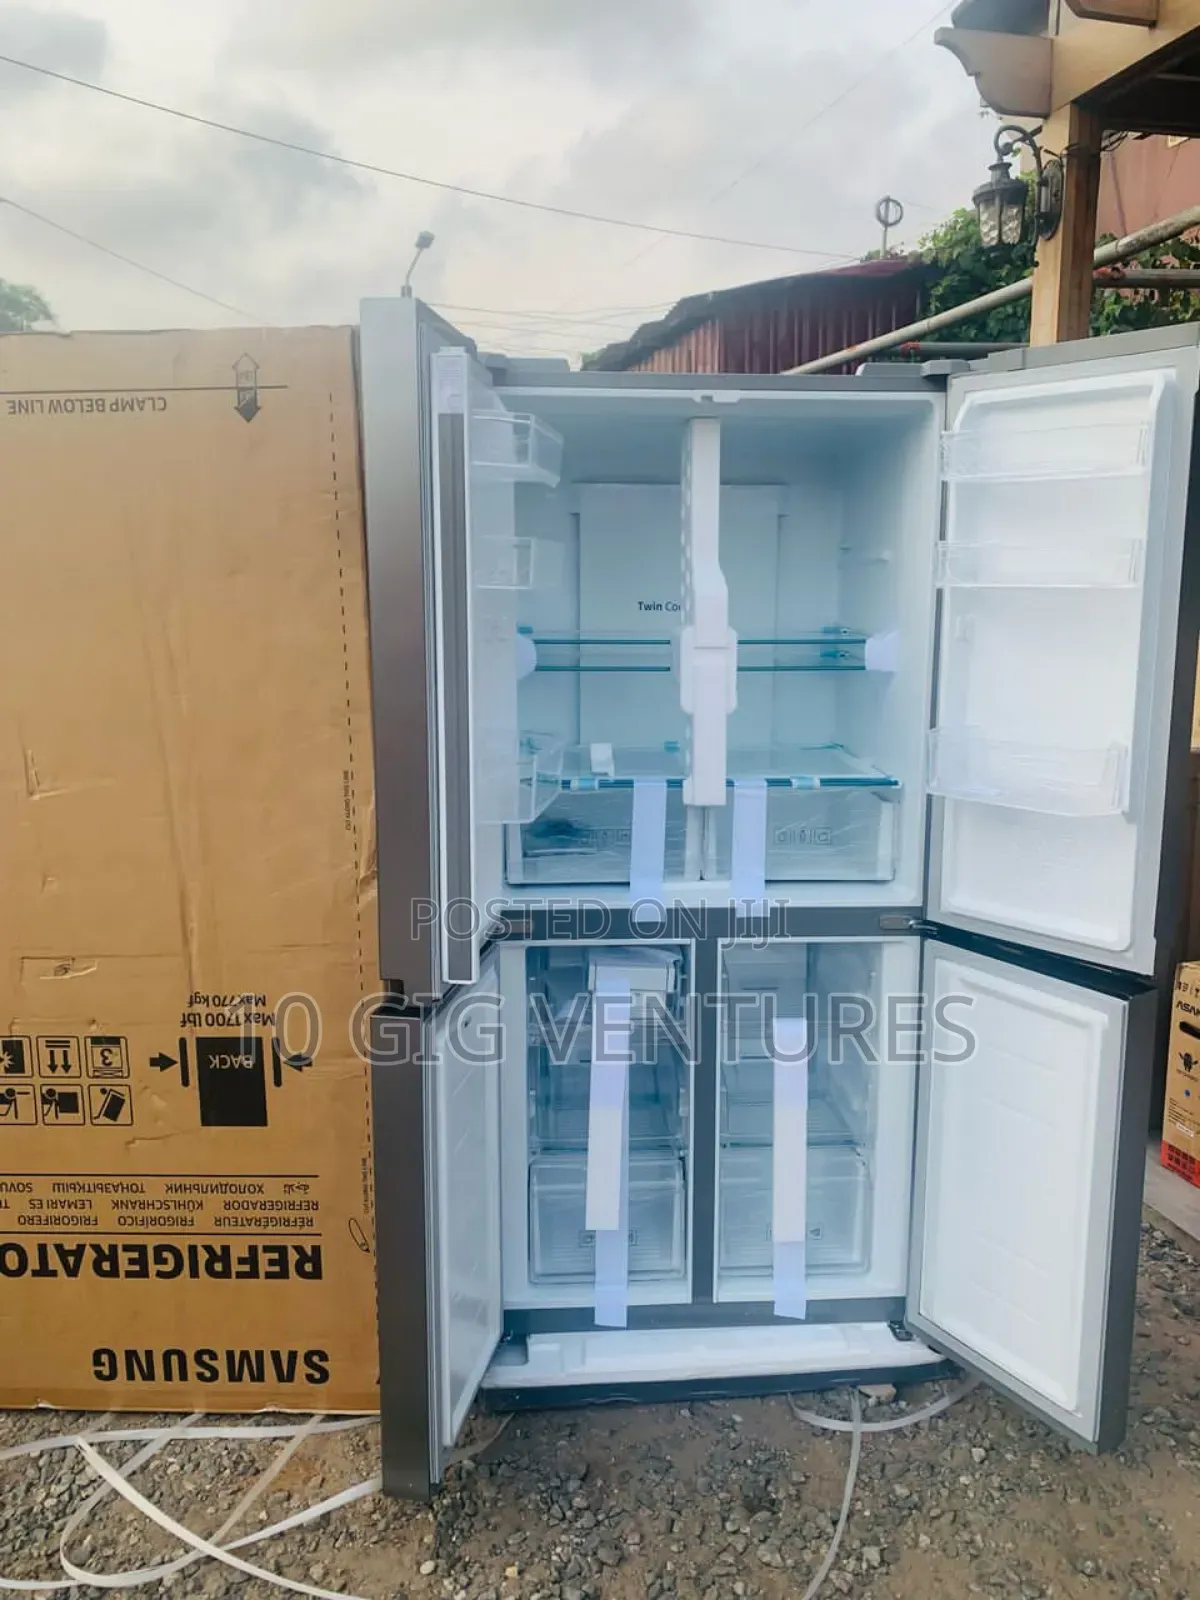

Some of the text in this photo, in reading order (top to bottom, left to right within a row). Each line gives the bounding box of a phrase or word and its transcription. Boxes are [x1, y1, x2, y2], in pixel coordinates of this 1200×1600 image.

[7, 396, 167, 415] CLAMP BELOW LINE
[637, 600, 662, 611] Twin
[188, 991, 210, 1008] kgf
[180, 1012, 275, 1028] Max 1700 lbf
[100, 1048, 113, 1066] 3
[208, 1054, 254, 1069] BACK
[165, 1182, 264, 1195] ХОЛОДИЛЬНИК
[29, 1198, 92, 1210] LEMARI ES
[111, 1199, 204, 1213] KÜHLSCHRANK
[223, 1199, 319, 1211] REFRIGERADOR
[17, 1214, 99, 1226] FRIGORIFERO
[117, 1215, 195, 1229] FRIGORÍFICO
[214, 1216, 314, 1230] RÉFRIGÉRATEUR
[0, 1243, 323, 1280] REFRIGERATO
[92, 1348, 330, 1385] SAMSUNG
